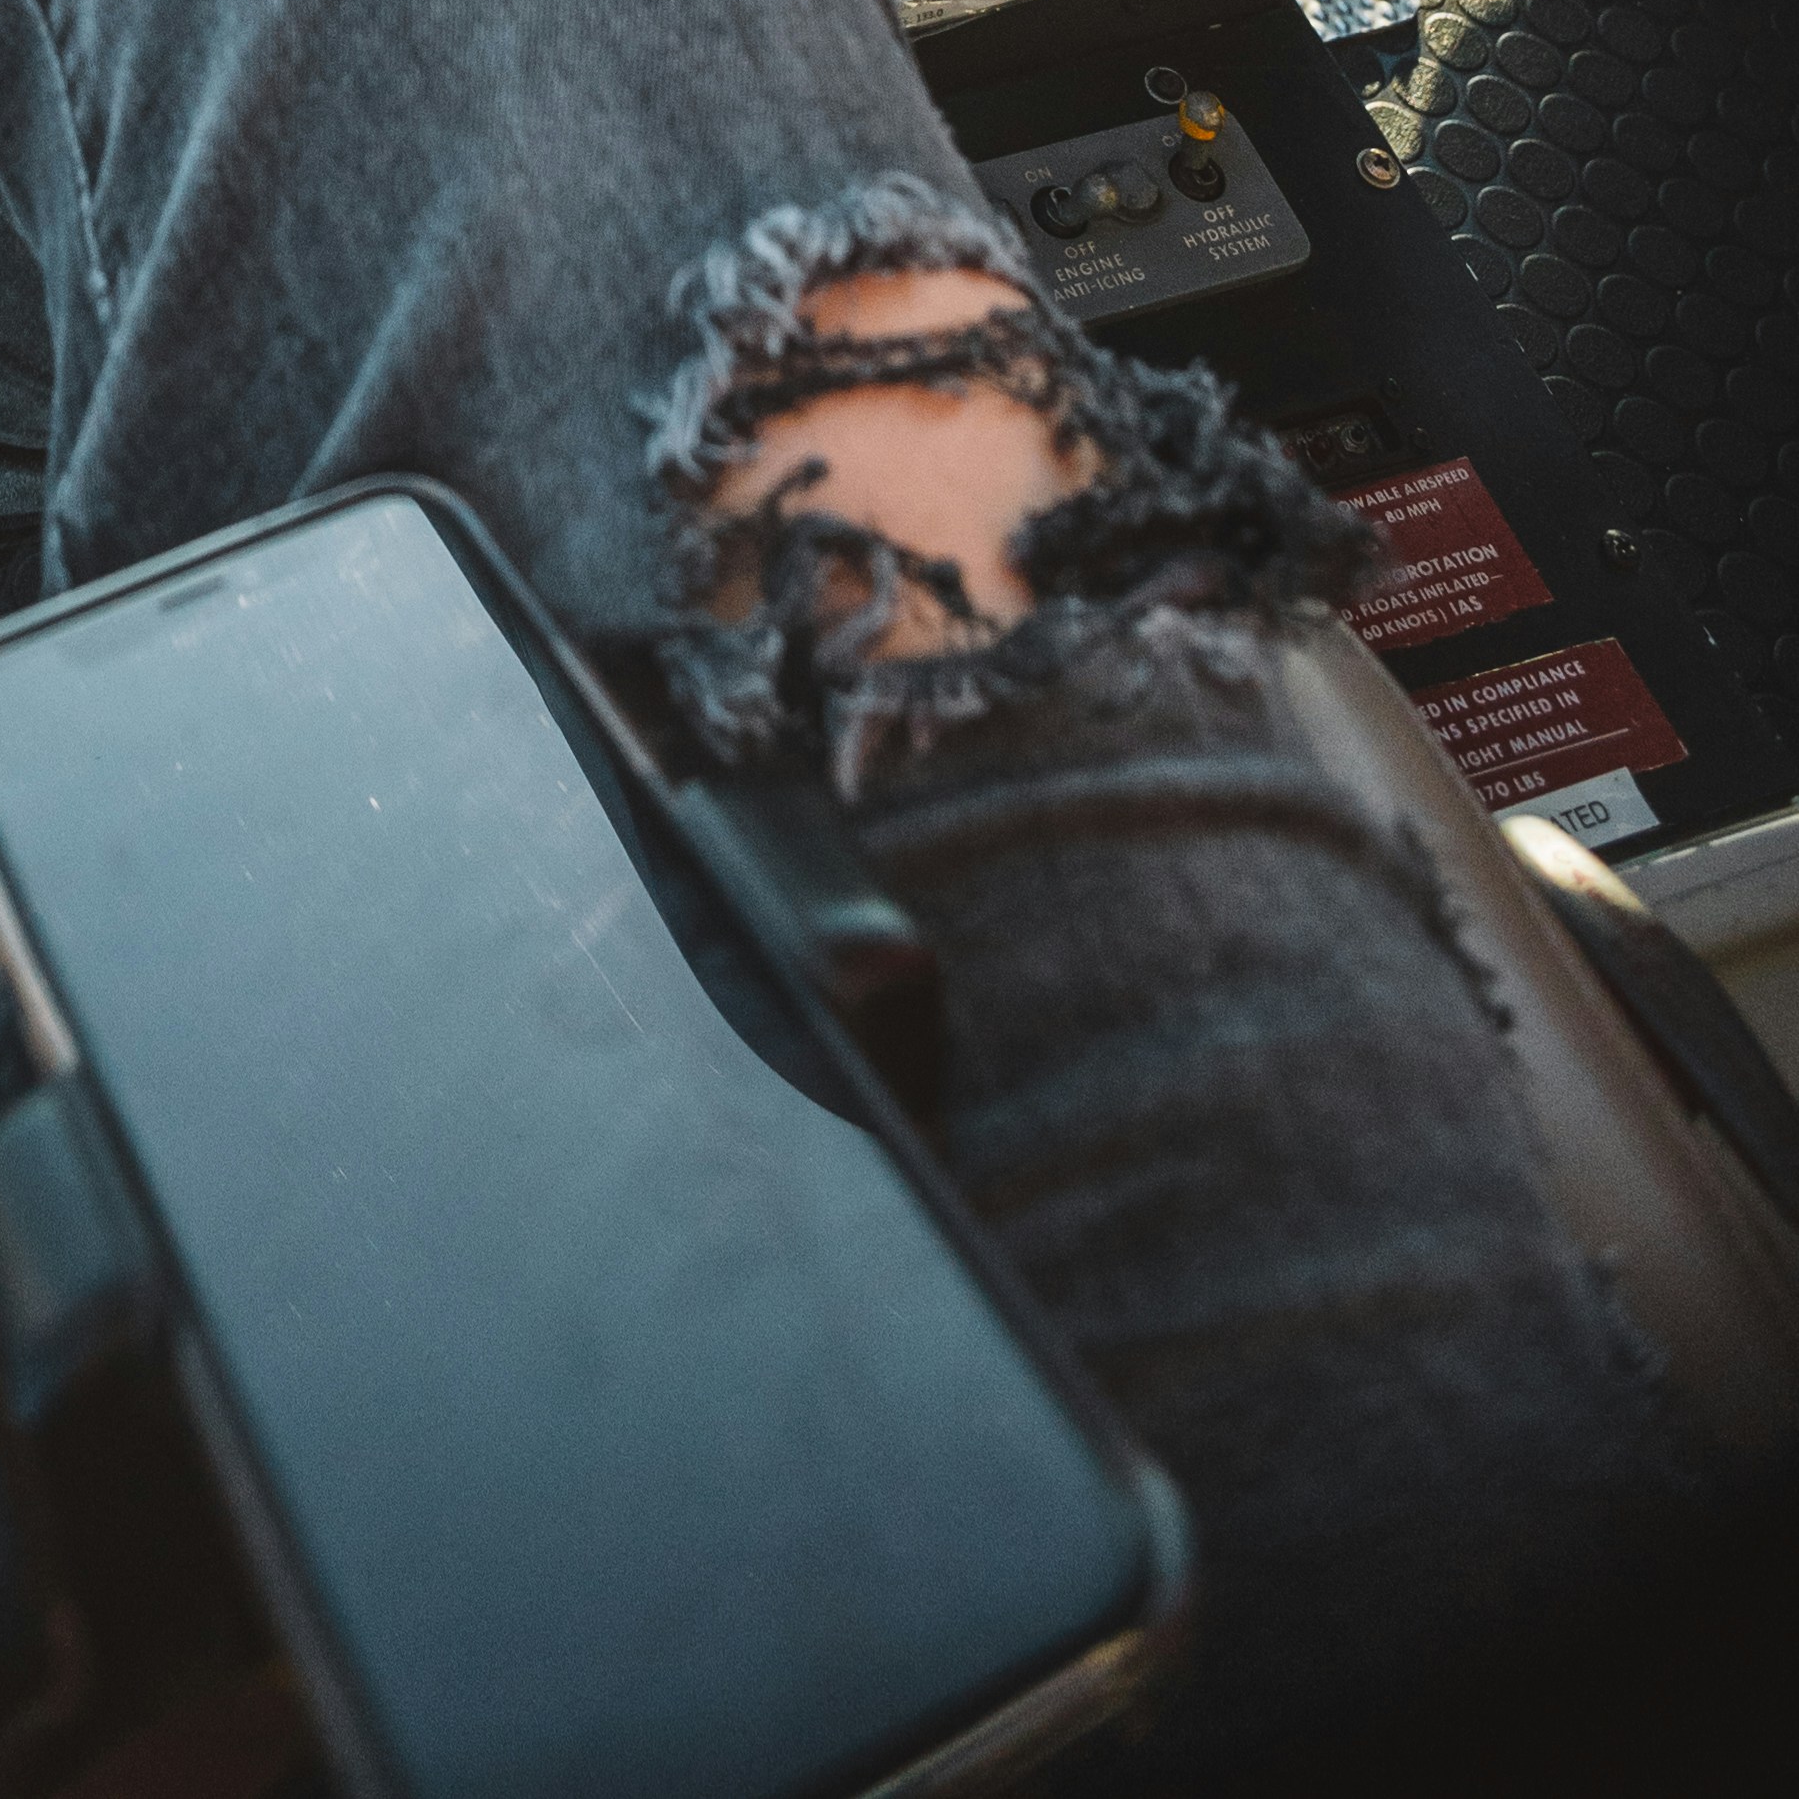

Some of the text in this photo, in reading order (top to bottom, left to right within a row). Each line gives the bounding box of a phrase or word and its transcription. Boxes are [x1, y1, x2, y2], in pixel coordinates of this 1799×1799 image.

[1204, 204, 1236, 223] OFF
[1182, 213, 1273, 248] HYDRAULIC
[1208, 235, 1271, 260] SYSTEM
[1055, 253, 1124, 282] ENGINE
[1053, 267, 1146, 301] ANTI-ICING
[1404, 468, 1470, 496] AIRSPEED
[1385, 498, 1442, 523] 80 MPH
[1359, 590, 1418, 617] FLOATS
[1450, 596, 1483, 616] IAS
[1443, 660, 1586, 713] IN COMPLIANCE
[1467, 690, 1581, 734] SPECIFIED IN
[1509, 719, 1588, 754] MANUAL
[1513, 771, 1546, 793] LBS
